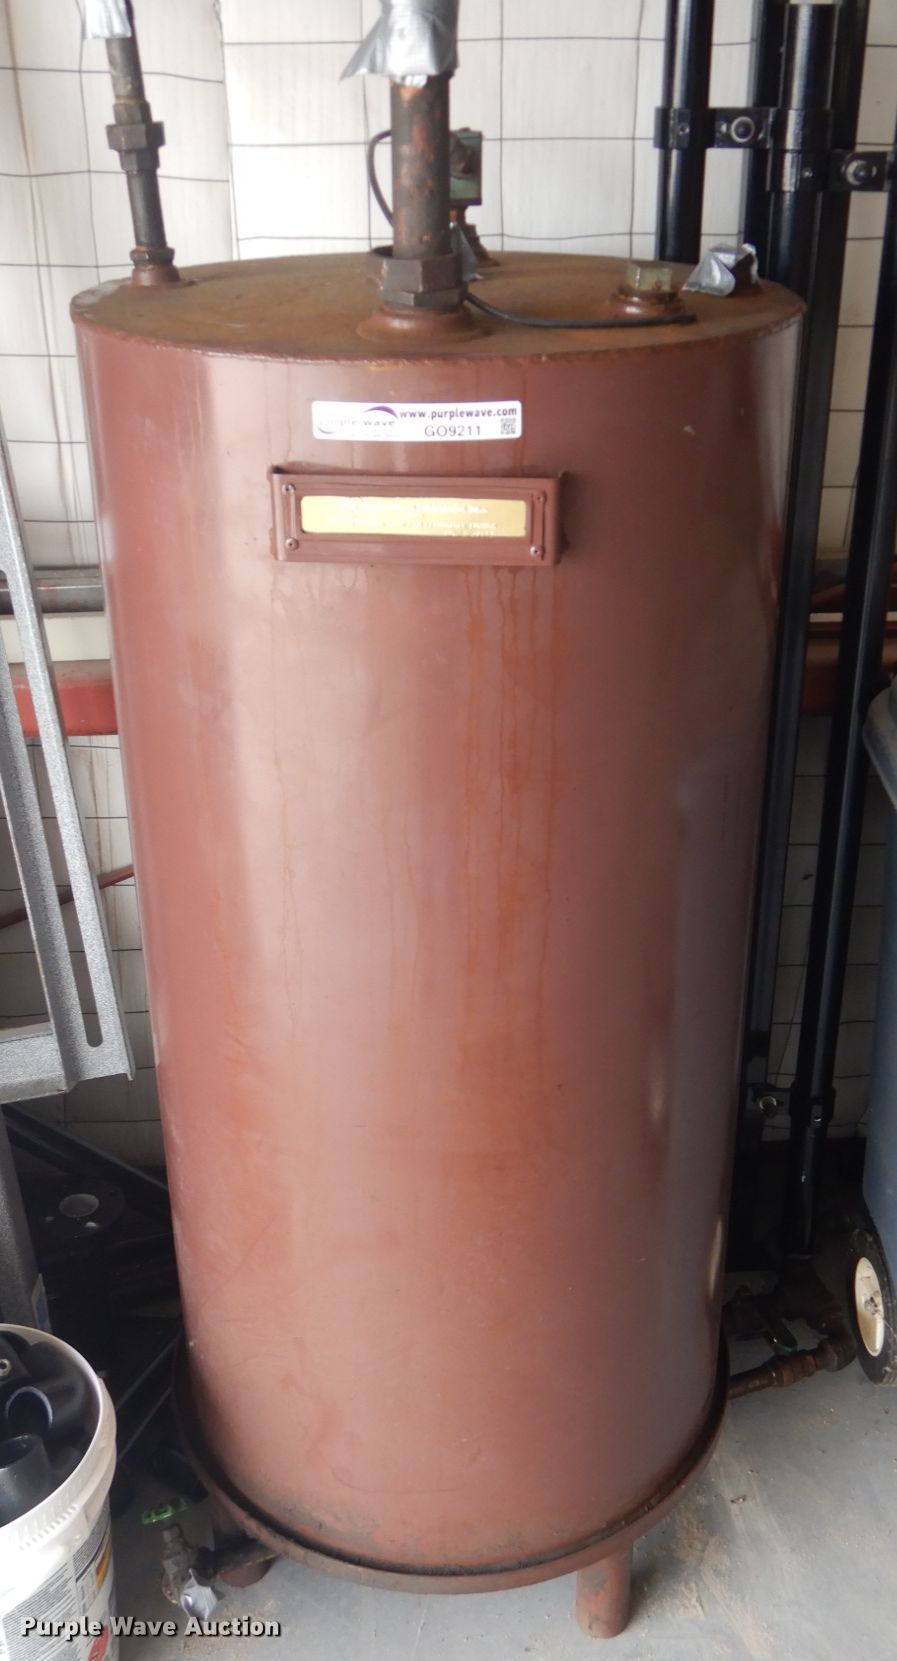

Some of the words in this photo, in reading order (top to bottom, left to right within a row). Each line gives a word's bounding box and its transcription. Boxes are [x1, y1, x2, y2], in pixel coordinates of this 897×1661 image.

[400, 406, 517, 421] www.purplewave.com
[363, 419, 395, 428] wave
[424, 425, 482, 438] GO9211
